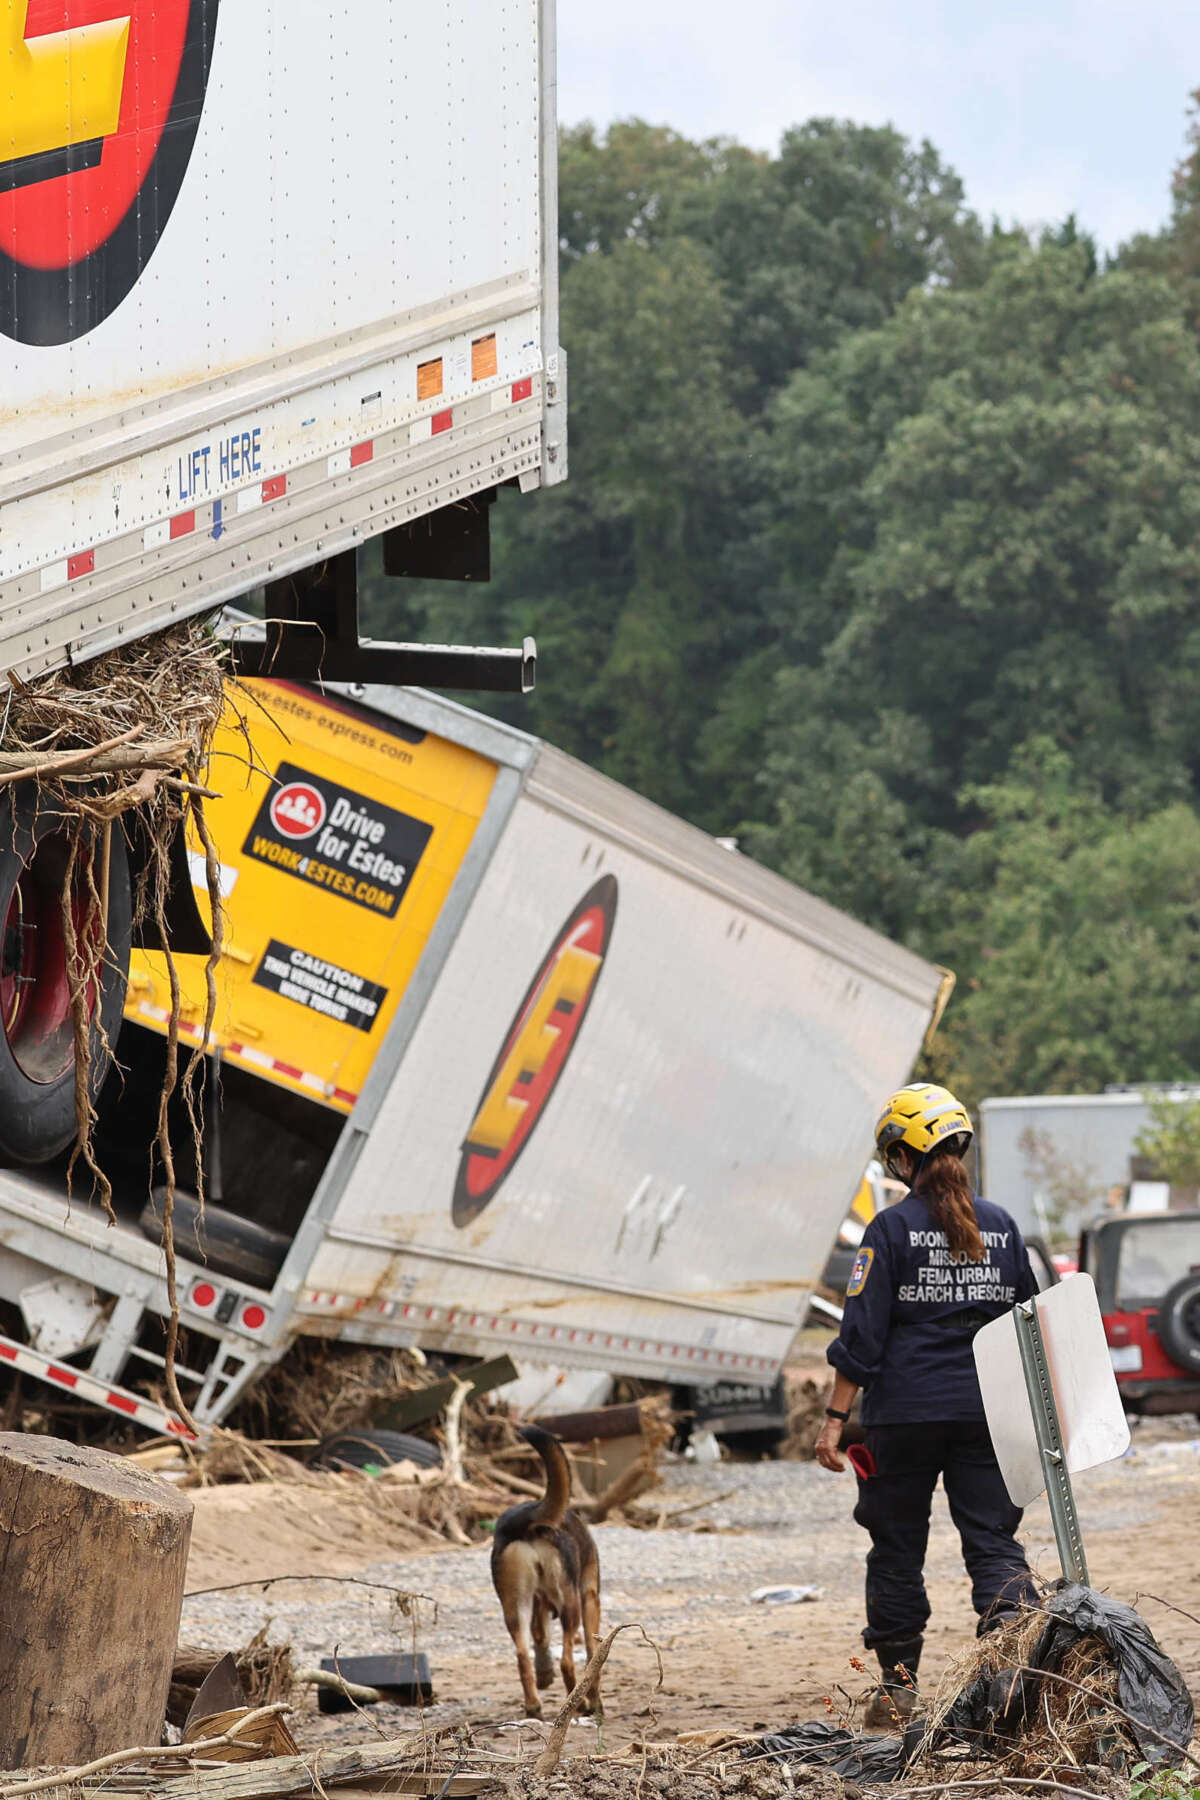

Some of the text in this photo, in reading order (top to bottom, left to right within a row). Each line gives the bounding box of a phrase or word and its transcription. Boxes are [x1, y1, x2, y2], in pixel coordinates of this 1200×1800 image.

[178, 427, 261, 500] LIFT HERE
[328, 796, 386, 844] Drive
[251, 835, 396, 912] WORK4ESTES.COM
[315, 826, 406, 887] for Estes
[289, 949, 365, 993] CAUTION
[289, 966, 337, 999] VEHICLE
[898, 1284, 1016, 1303] SEARCH & RESCUE
[918, 1267, 1001, 1285] FEMA URBAN
